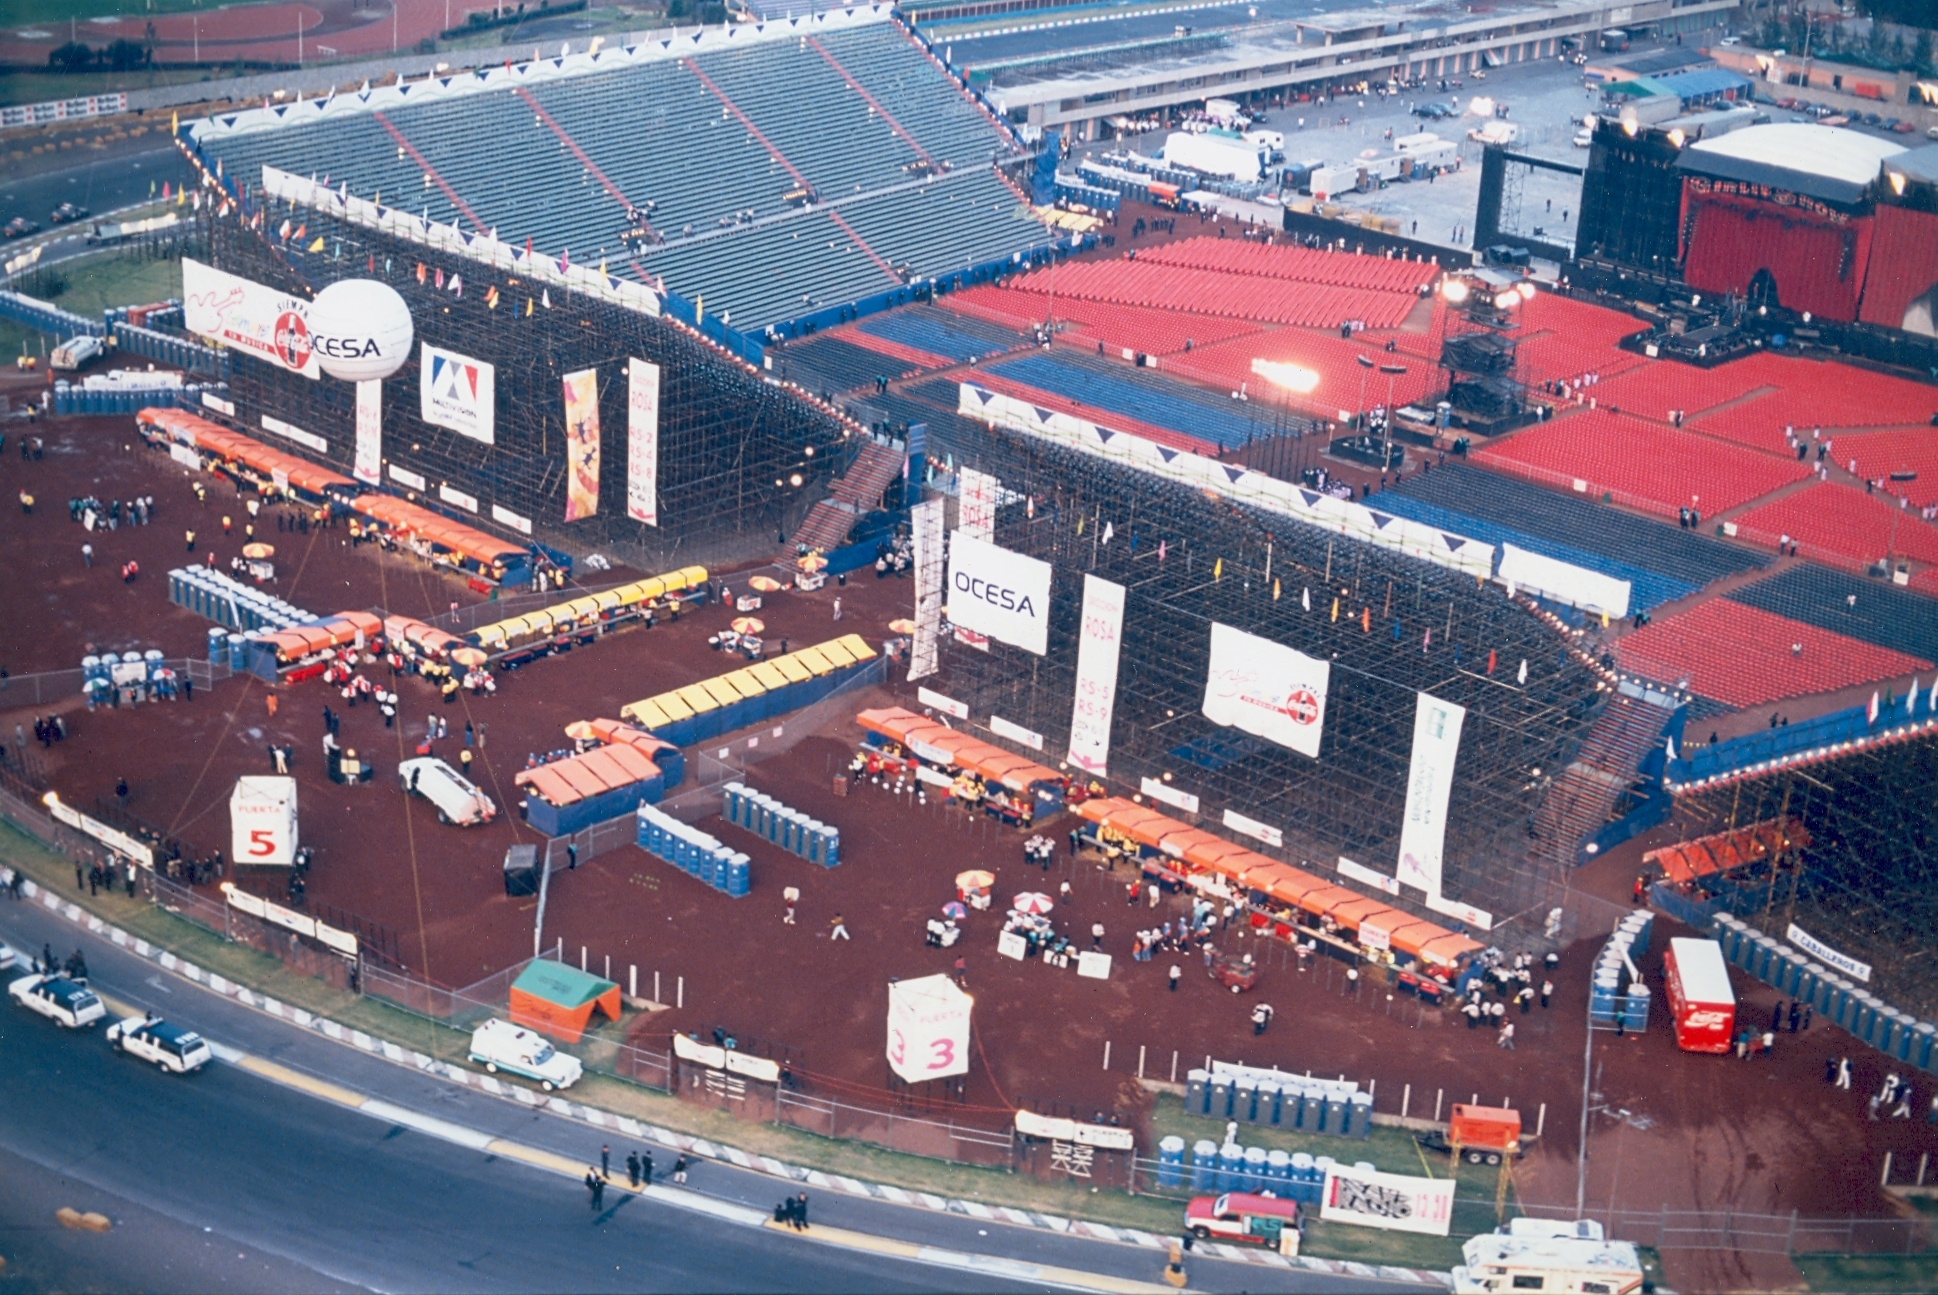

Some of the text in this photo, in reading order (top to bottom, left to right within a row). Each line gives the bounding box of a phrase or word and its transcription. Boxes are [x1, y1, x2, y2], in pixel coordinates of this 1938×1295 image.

[955, 571, 1035, 618] OCESA
[1085, 615, 1115, 642] ROSA
[239, 805, 281, 814] PUERTA
[248, 830, 276, 857] 5
[1801, 936, 1855, 972] CABALLEROS
[926, 1038, 955, 1070] 3
